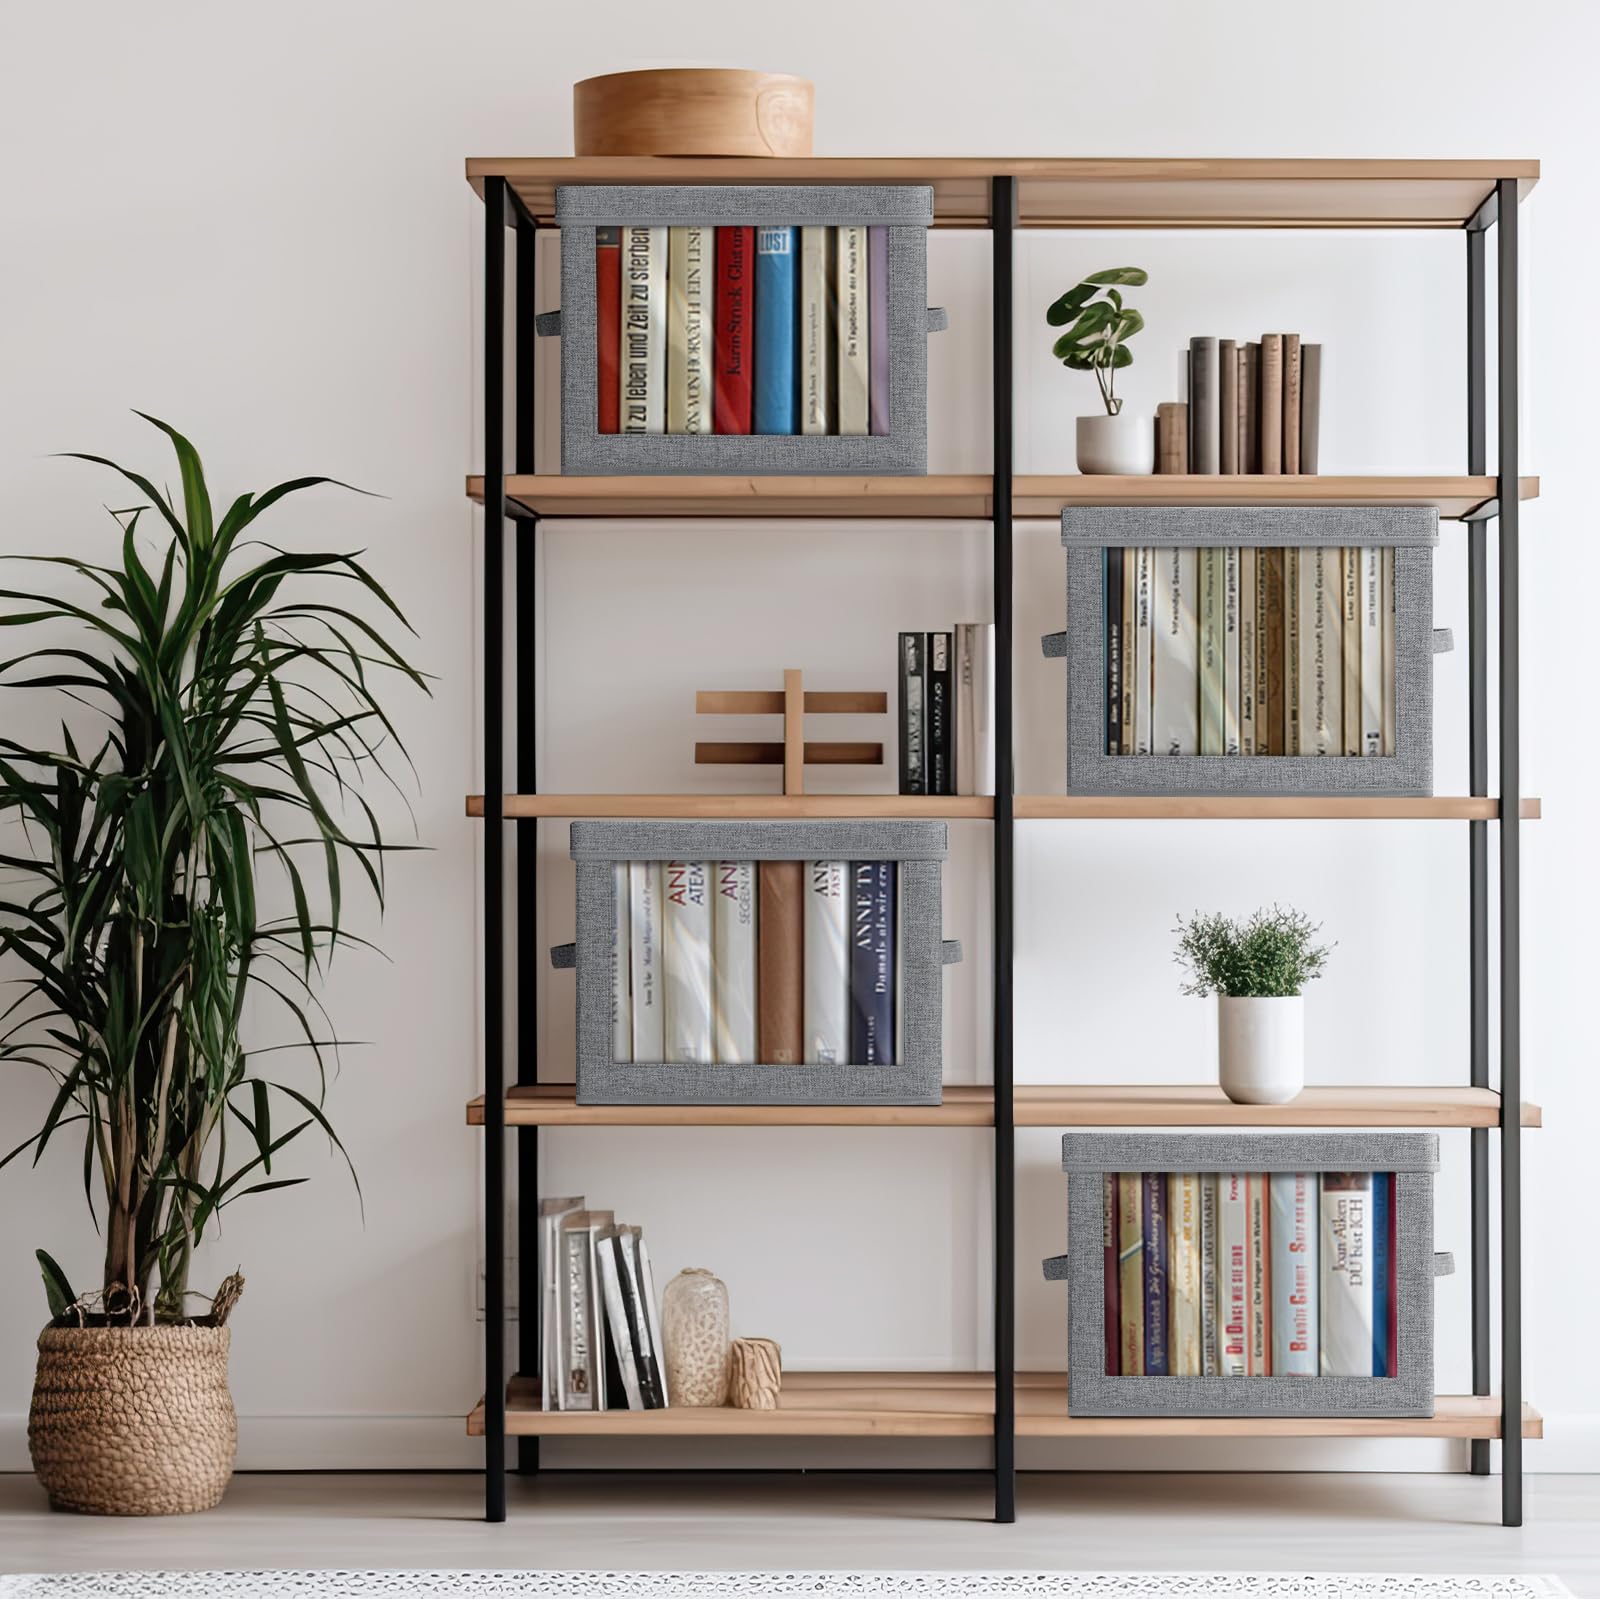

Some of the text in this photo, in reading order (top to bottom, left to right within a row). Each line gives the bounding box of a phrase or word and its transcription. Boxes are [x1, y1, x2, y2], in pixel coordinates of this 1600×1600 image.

[629, 228, 650, 280] sterben
[760, 232, 788, 252] LUST
[630, 284, 649, 302] zu
[627, 304, 649, 330] Zeit
[627, 333, 648, 358] und
[848, 344, 858, 357] Die
[627, 362, 648, 400] leben
[629, 405, 647, 421] zu
[830, 868, 841, 897] FAST
[739, 882, 751, 925] SEGELN
[856, 863, 872, 950] ANNE TY
[876, 890, 887, 914] wir
[875, 942, 888, 993] Damals
[1203, 1186, 1214, 1240] UMARMT
[1331, 1198, 1349, 1272] Joan Aiken
[1348, 1198, 1363, 1287] DU bist ICH
